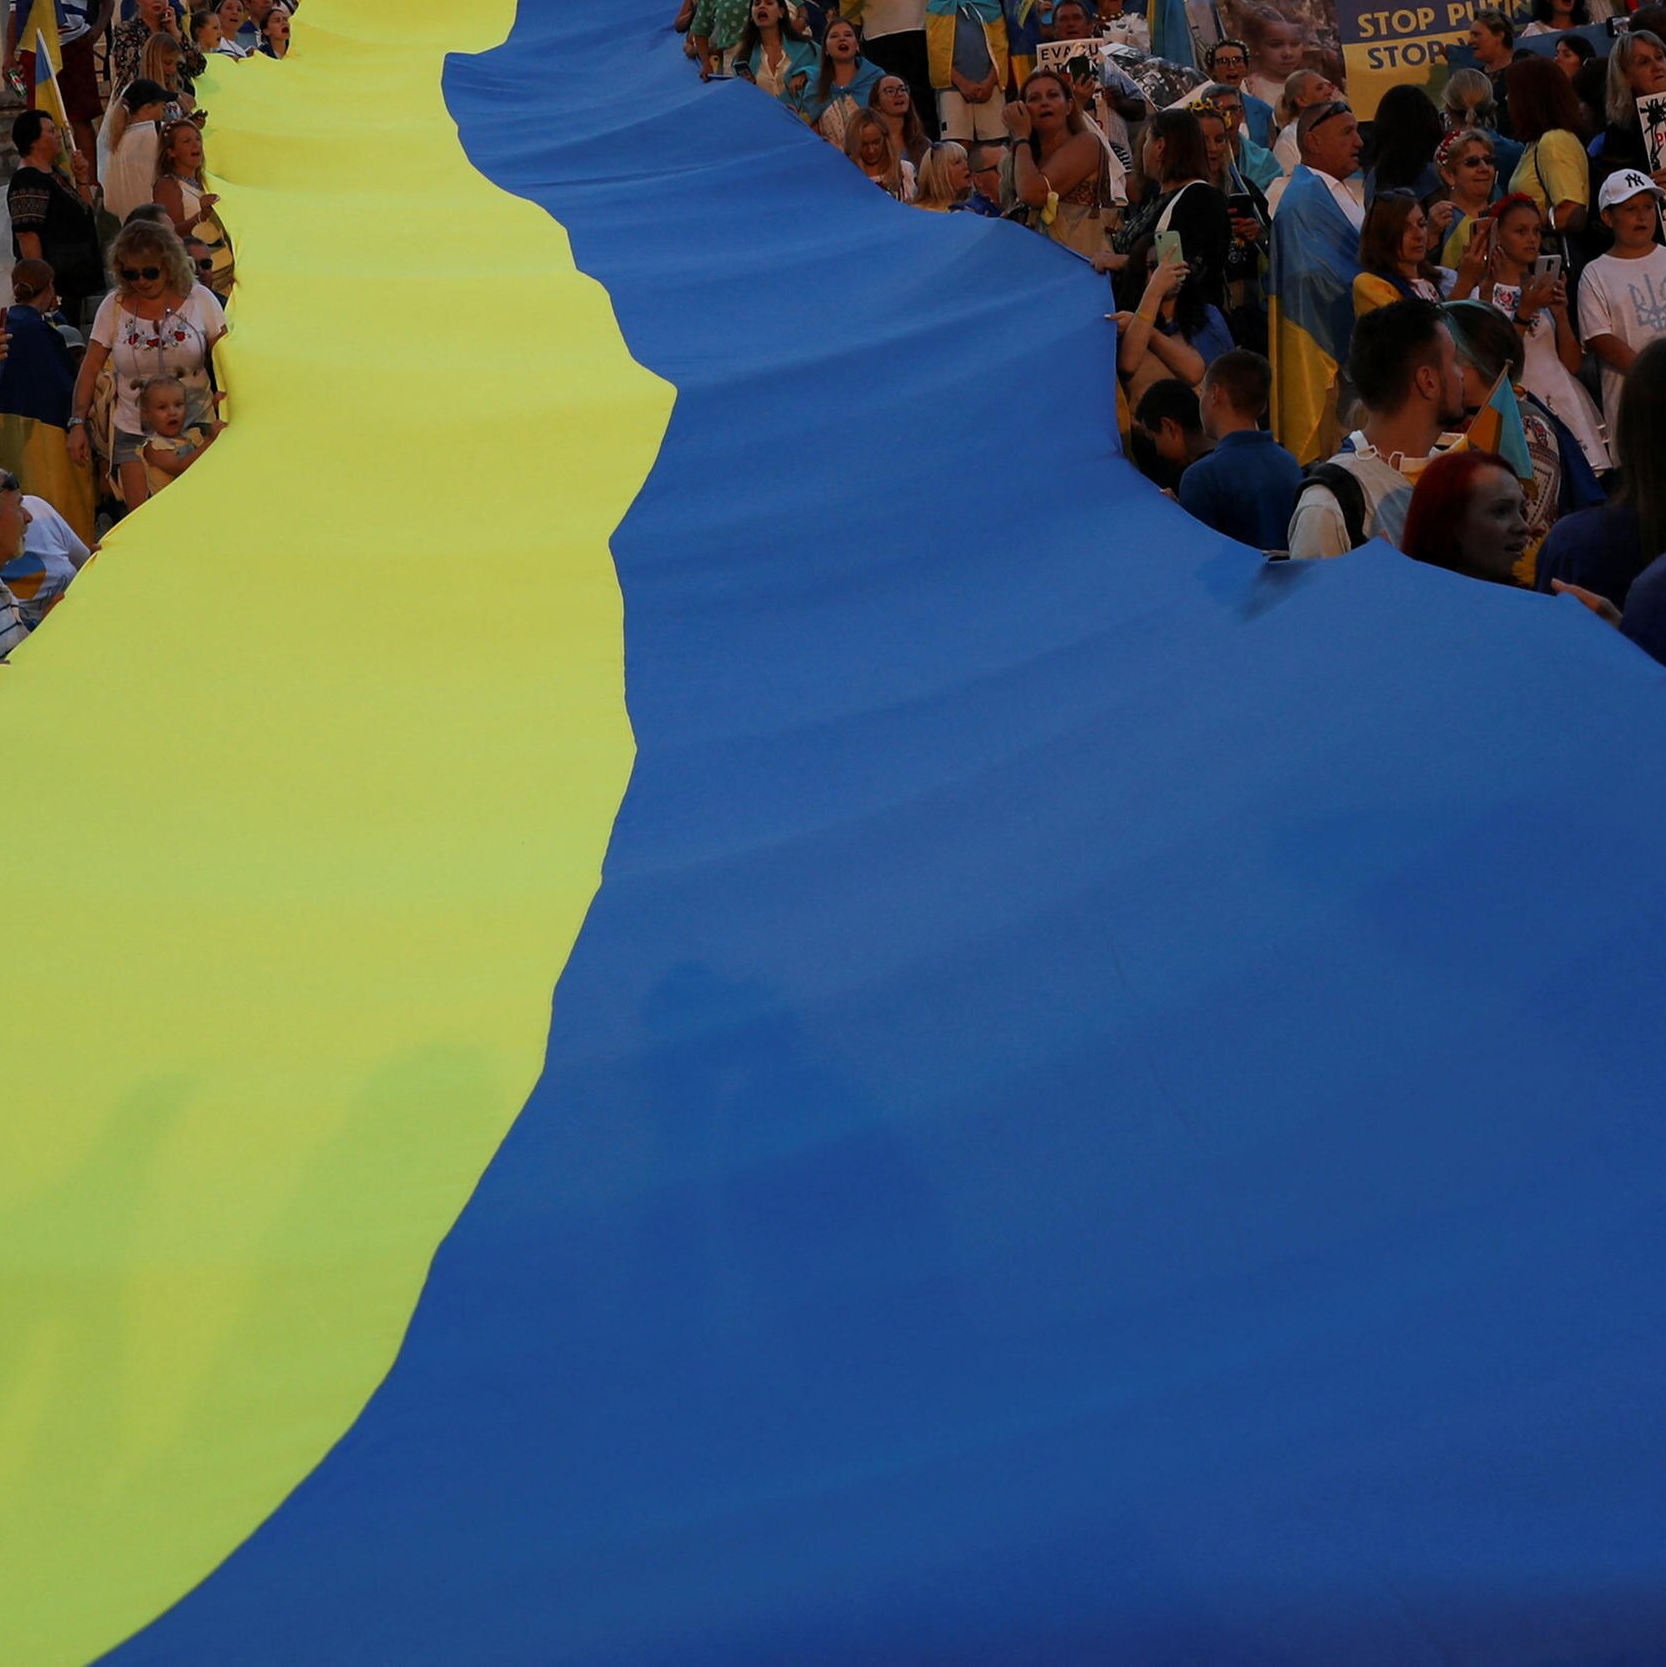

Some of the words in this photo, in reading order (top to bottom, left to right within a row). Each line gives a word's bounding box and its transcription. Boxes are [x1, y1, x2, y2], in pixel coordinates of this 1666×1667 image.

[1357, 6, 1436, 38] STOP
[1367, 40, 1448, 70] STOP
[1625, 173, 1646, 188] NY
